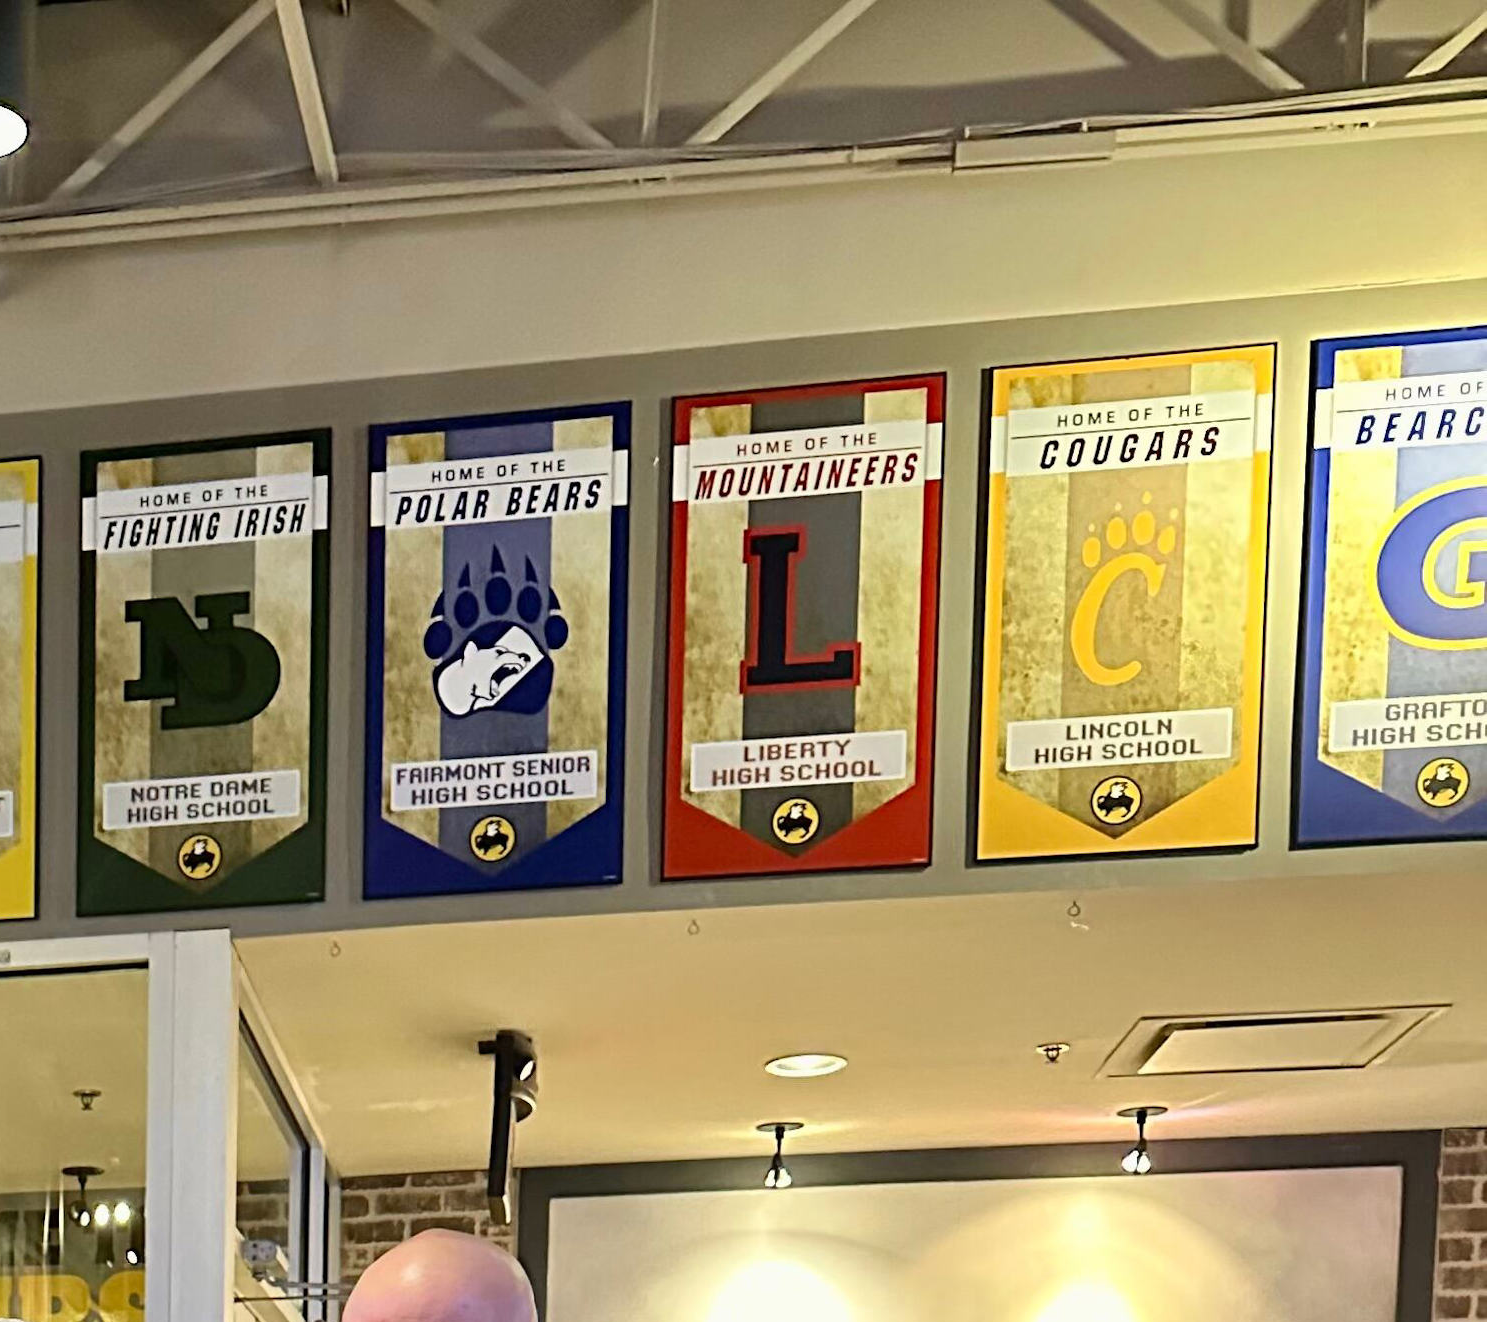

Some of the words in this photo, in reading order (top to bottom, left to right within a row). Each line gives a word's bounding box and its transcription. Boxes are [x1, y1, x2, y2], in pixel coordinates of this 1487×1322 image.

[1386, 384, 1446, 401] HOME
[1460, 381, 1484, 395] OF
[1057, 410, 1116, 428] HOME
[1128, 408, 1154, 422] OF
[1165, 403, 1204, 419] THE
[1355, 406, 1485, 446] BEARC
[737, 440, 793, 457] HOME
[805, 436, 829, 451] OF
[841, 432, 878, 447] THE
[1039, 426, 1220, 470] COUGARS
[432, 466, 485, 483] HOME
[496, 462, 520, 477] OF
[531, 458, 567, 474] THE
[694, 452, 918, 501] MOUNTAINEERS
[139, 493, 192, 508] HOME
[202, 488, 225, 502] OF
[234, 484, 269, 499] THE
[395, 488, 491, 526] POLAR
[505, 478, 602, 516] BEARS
[102, 510, 220, 551] FIGHTING
[232, 502, 307, 538] IRISH
[1375, 474, 1487, 650] G
[741, 522, 861, 696] L
[1069, 551, 1168, 687] C
[123, 590, 281, 731] ND
[1385, 699, 1487, 721] GRAFTO
[1065, 718, 1173, 741] LINCOLN
[1352, 726, 1416, 747] HIGH
[1426, 722, 1487, 742] SCH
[743, 739, 851, 763] LIBERTY
[1034, 745, 1093, 764] HIGH
[1101, 738, 1204, 760] SCHOOL
[396, 760, 507, 787] FAIRMONT
[513, 755, 592, 778] SENIOR
[712, 766, 771, 787] HIGH
[779, 760, 882, 782] SCHOOL
[130, 780, 203, 805] NOTRE
[210, 777, 273, 798] DAME
[410, 784, 473, 806] HIGH
[478, 778, 575, 802] SCHOOL
[127, 803, 181, 824] HIGH
[185, 797, 276, 820] SCHOOL
